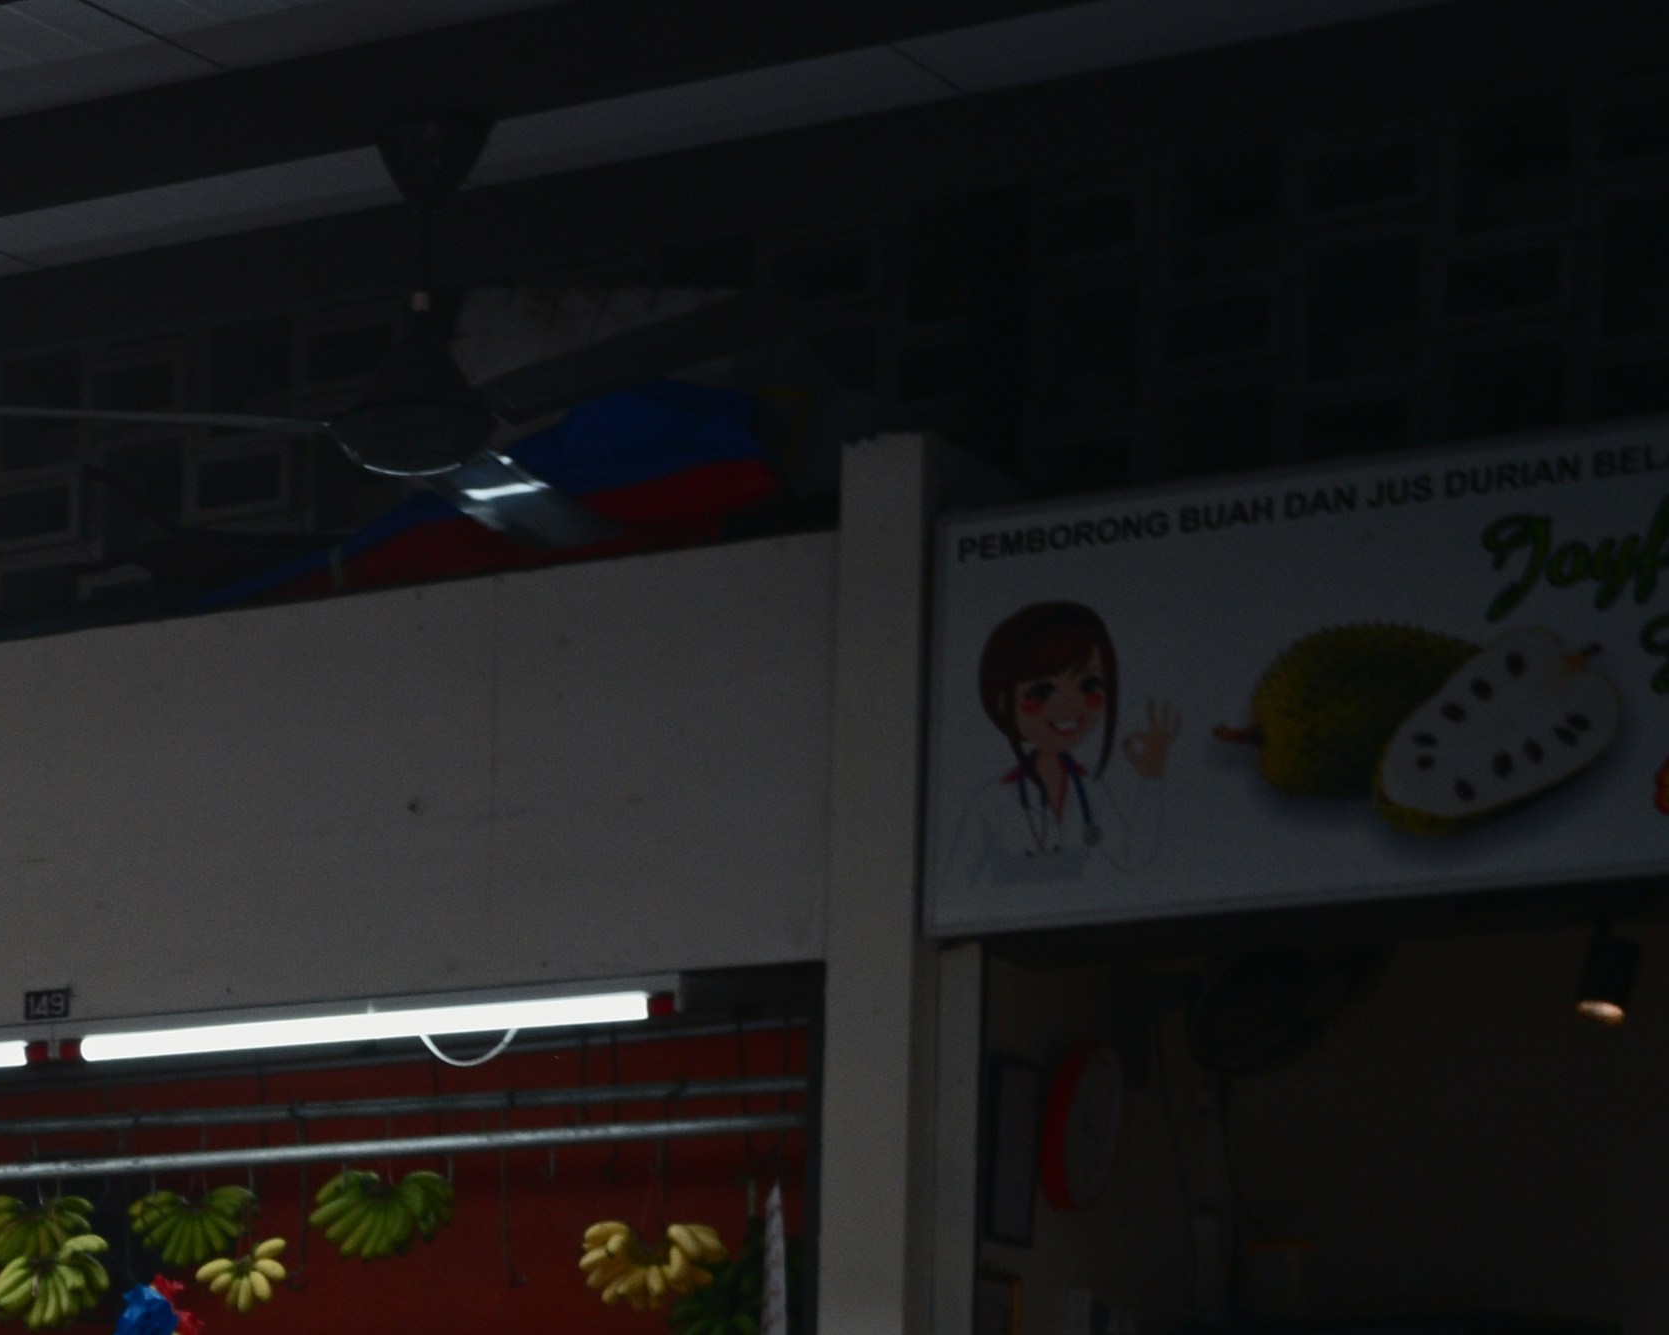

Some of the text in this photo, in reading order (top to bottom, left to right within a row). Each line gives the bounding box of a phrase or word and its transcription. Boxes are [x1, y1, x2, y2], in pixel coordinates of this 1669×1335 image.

[958, 508, 1170, 562] PEMBORONG
[1179, 497, 1274, 535] BUAH
[1283, 484, 1358, 520] DAN
[1365, 473, 1435, 508] JUS
[1443, 453, 1582, 499] DURIAN
[28, 991, 66, 1018] 149
